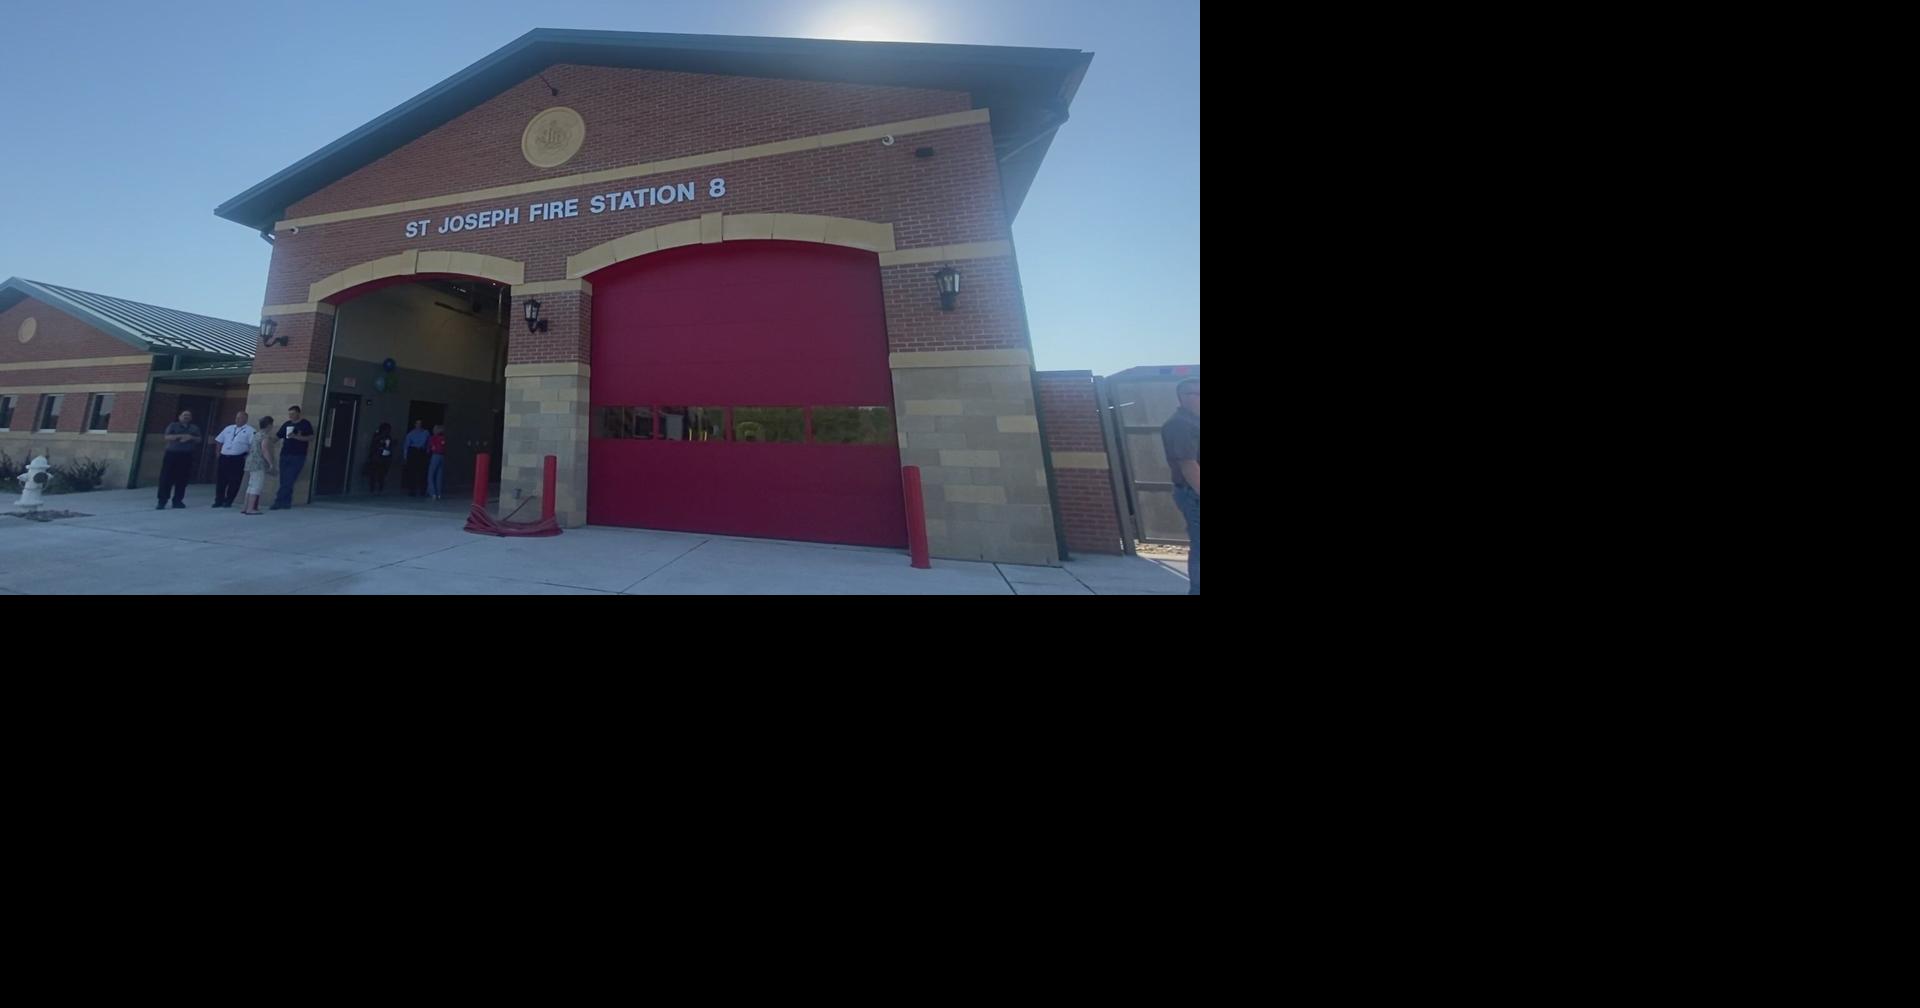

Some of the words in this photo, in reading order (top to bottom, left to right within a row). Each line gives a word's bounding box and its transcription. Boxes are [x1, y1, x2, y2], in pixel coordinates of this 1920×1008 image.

[405, 219, 431, 238] ST
[438, 207, 519, 234] JOSEPH
[529, 198, 579, 222] FIRE
[590, 181, 695, 214] STATION
[709, 178, 726, 197] 8
